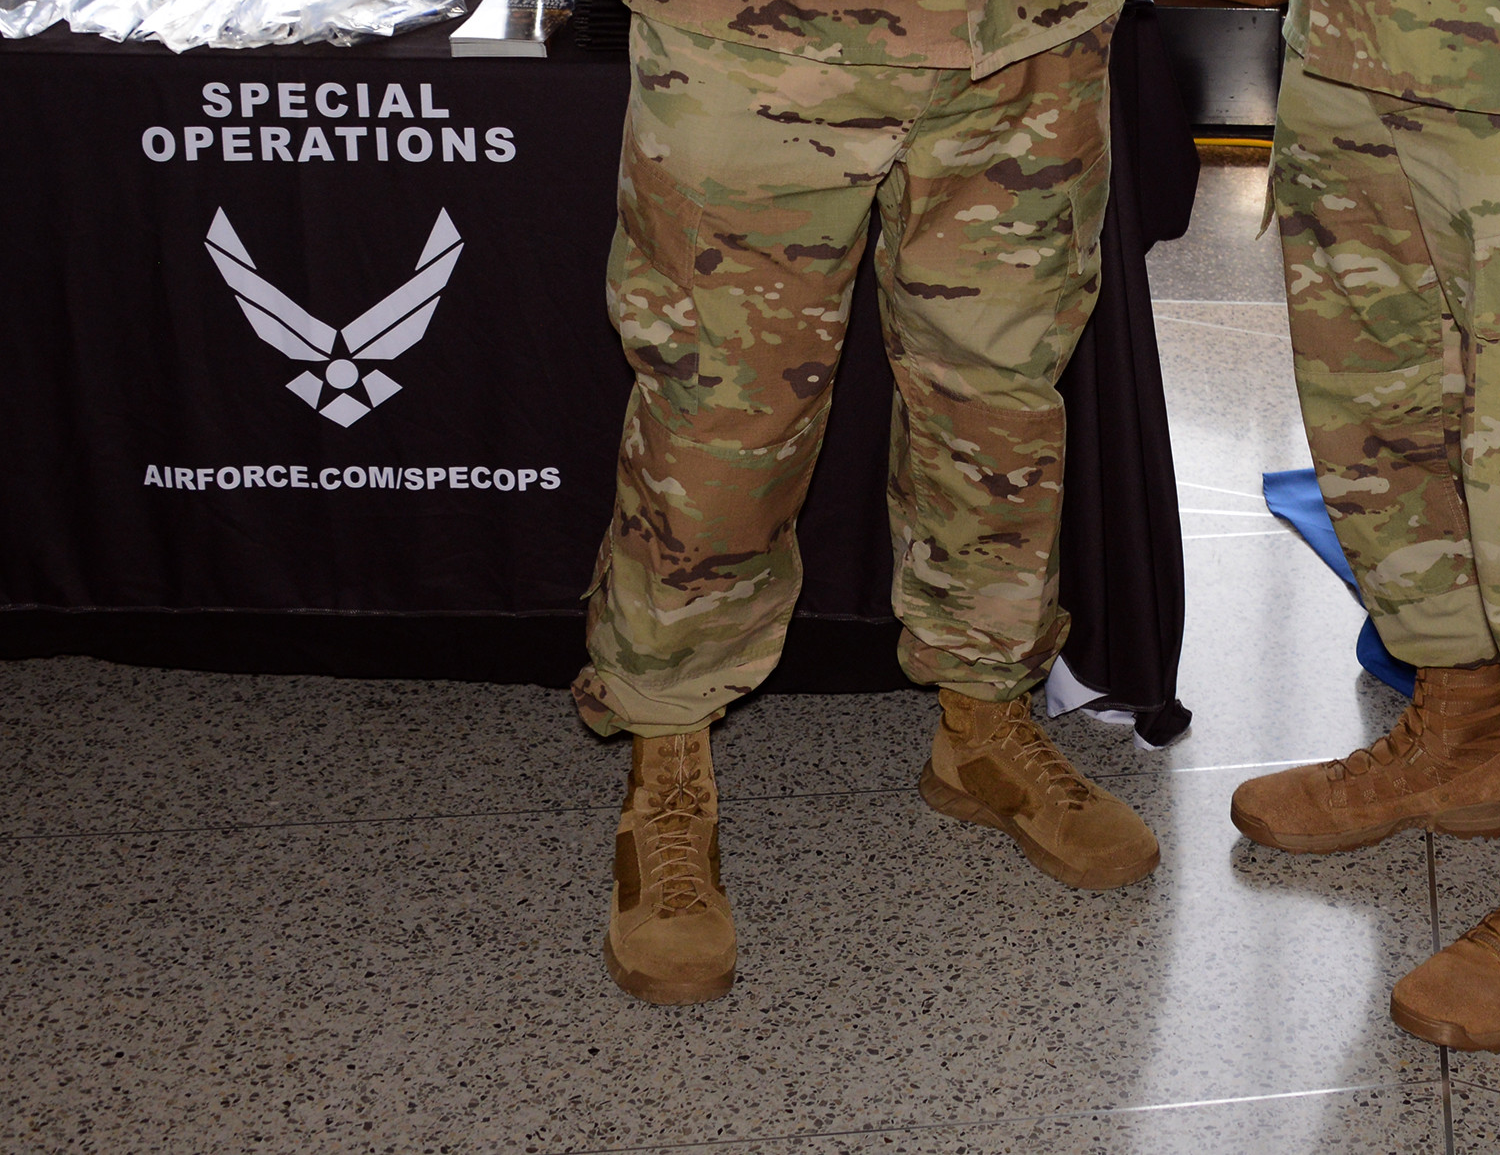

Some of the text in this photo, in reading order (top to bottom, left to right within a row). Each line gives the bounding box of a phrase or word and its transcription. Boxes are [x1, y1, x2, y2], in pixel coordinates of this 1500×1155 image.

[202, 82, 450, 118] SPECIAL
[141, 126, 517, 163] OPERATIONS
[143, 464, 562, 492] AIRFORCE.COM/SPECOPS
